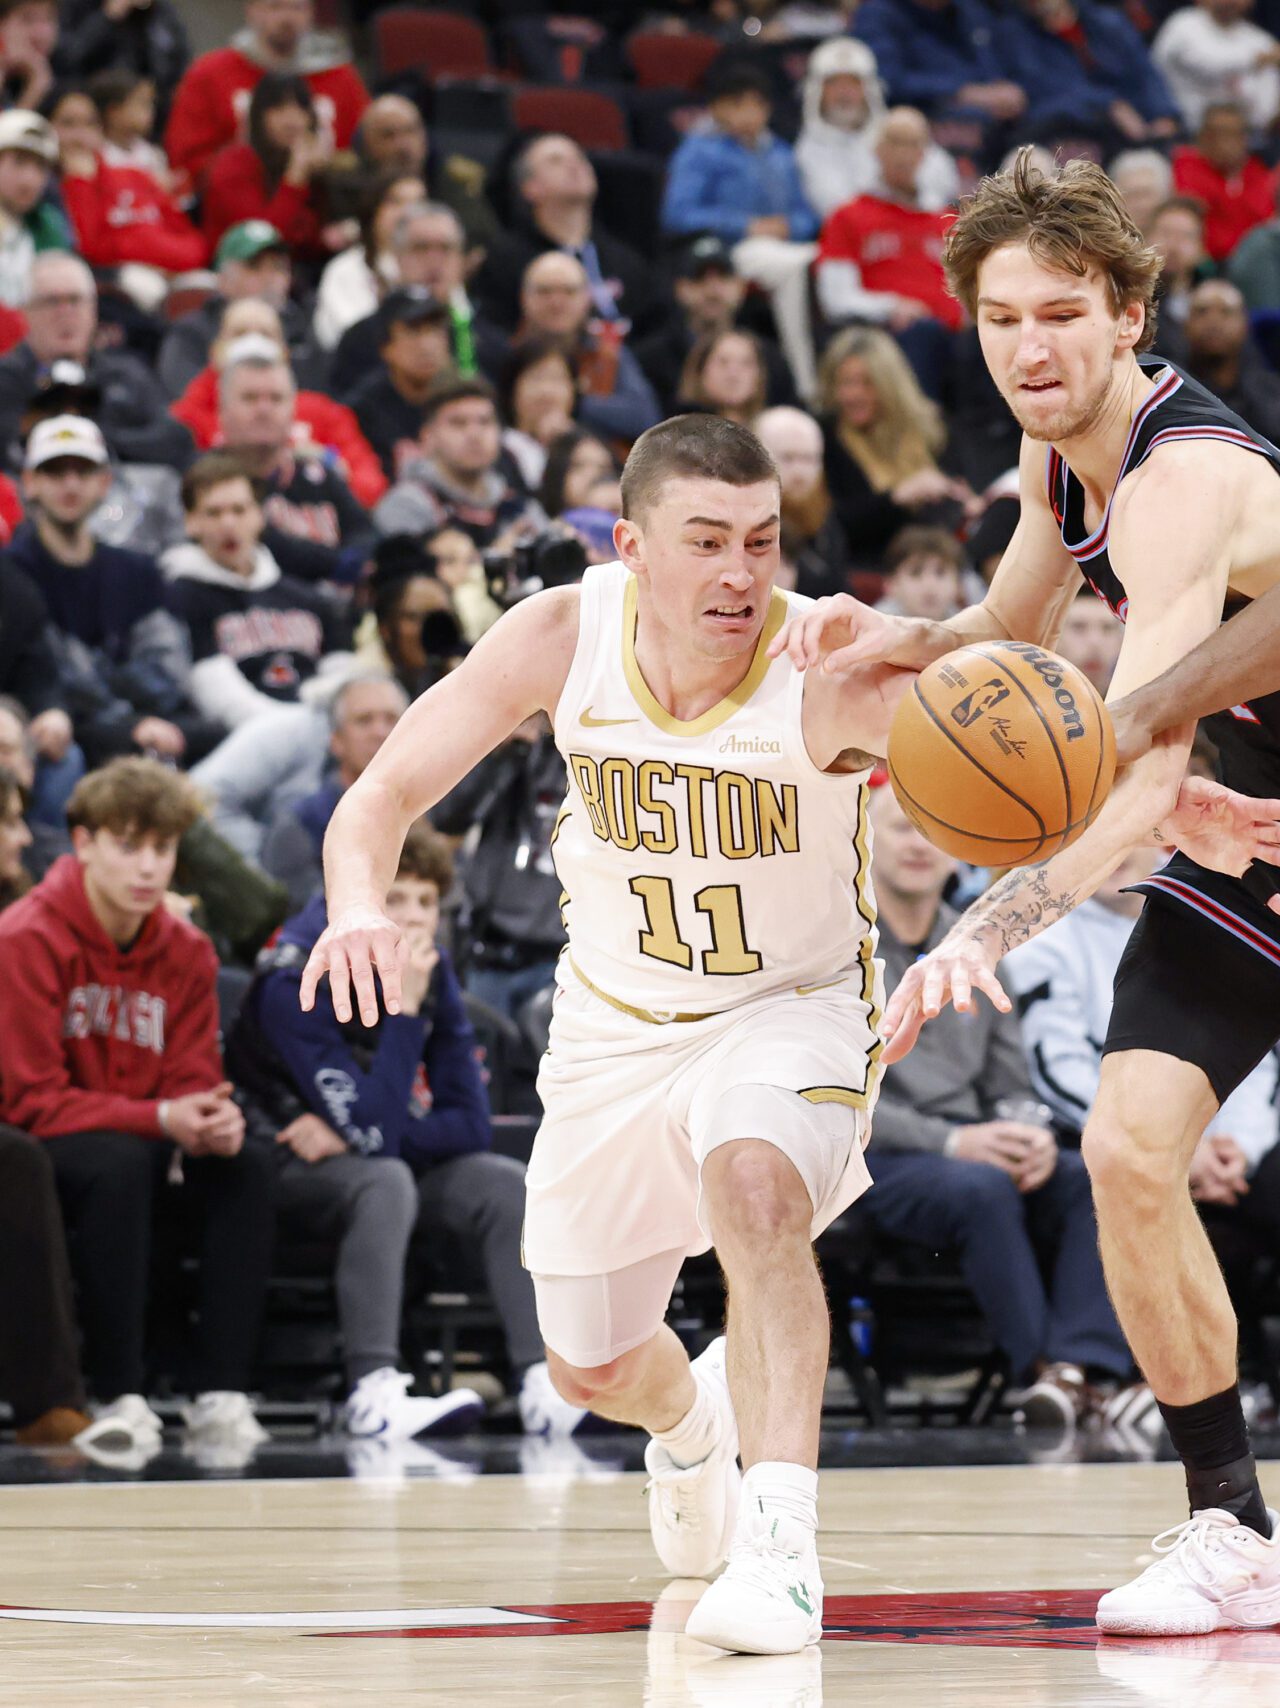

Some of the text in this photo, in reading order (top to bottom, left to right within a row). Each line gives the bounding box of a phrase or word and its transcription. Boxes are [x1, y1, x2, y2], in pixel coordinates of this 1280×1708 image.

[718, 734, 782, 754] Amica
[569, 753, 801, 860] BOSTON
[628, 875, 763, 976] 11
